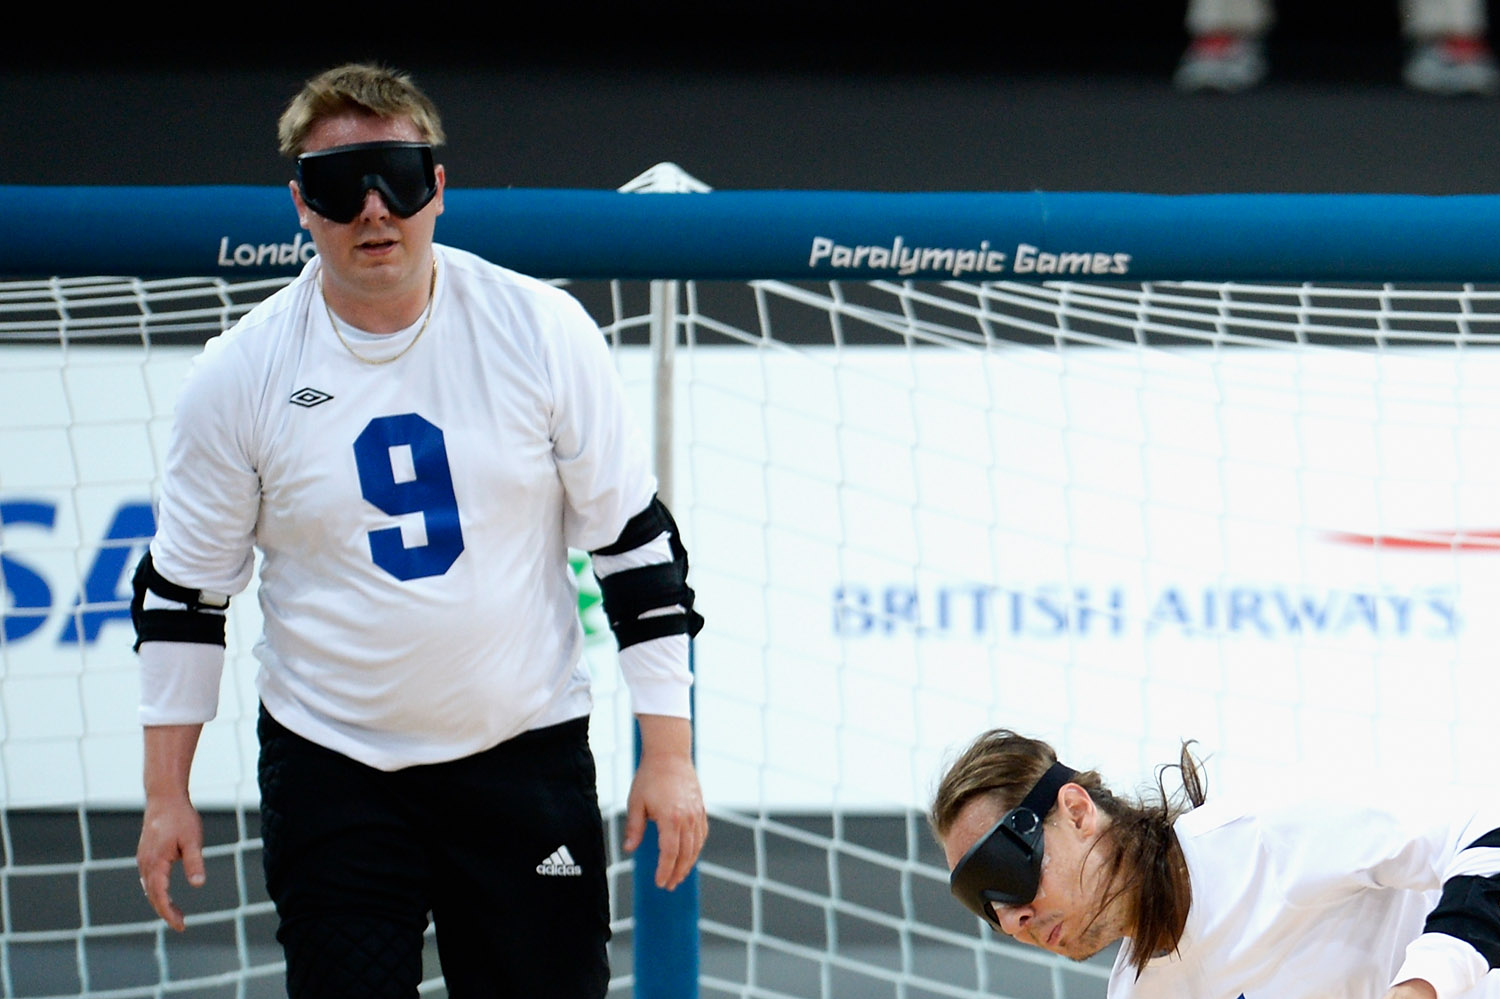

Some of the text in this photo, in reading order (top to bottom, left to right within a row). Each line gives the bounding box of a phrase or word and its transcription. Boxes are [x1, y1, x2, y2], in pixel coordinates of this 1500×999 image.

[217, 232, 318, 267] Londo
[809, 235, 1132, 277] Paralympic Games
[353, 412, 466, 582] 9
[832, 584, 1462, 639] BRITISH AIRWAYS
[536, 863, 582, 876] adidas
